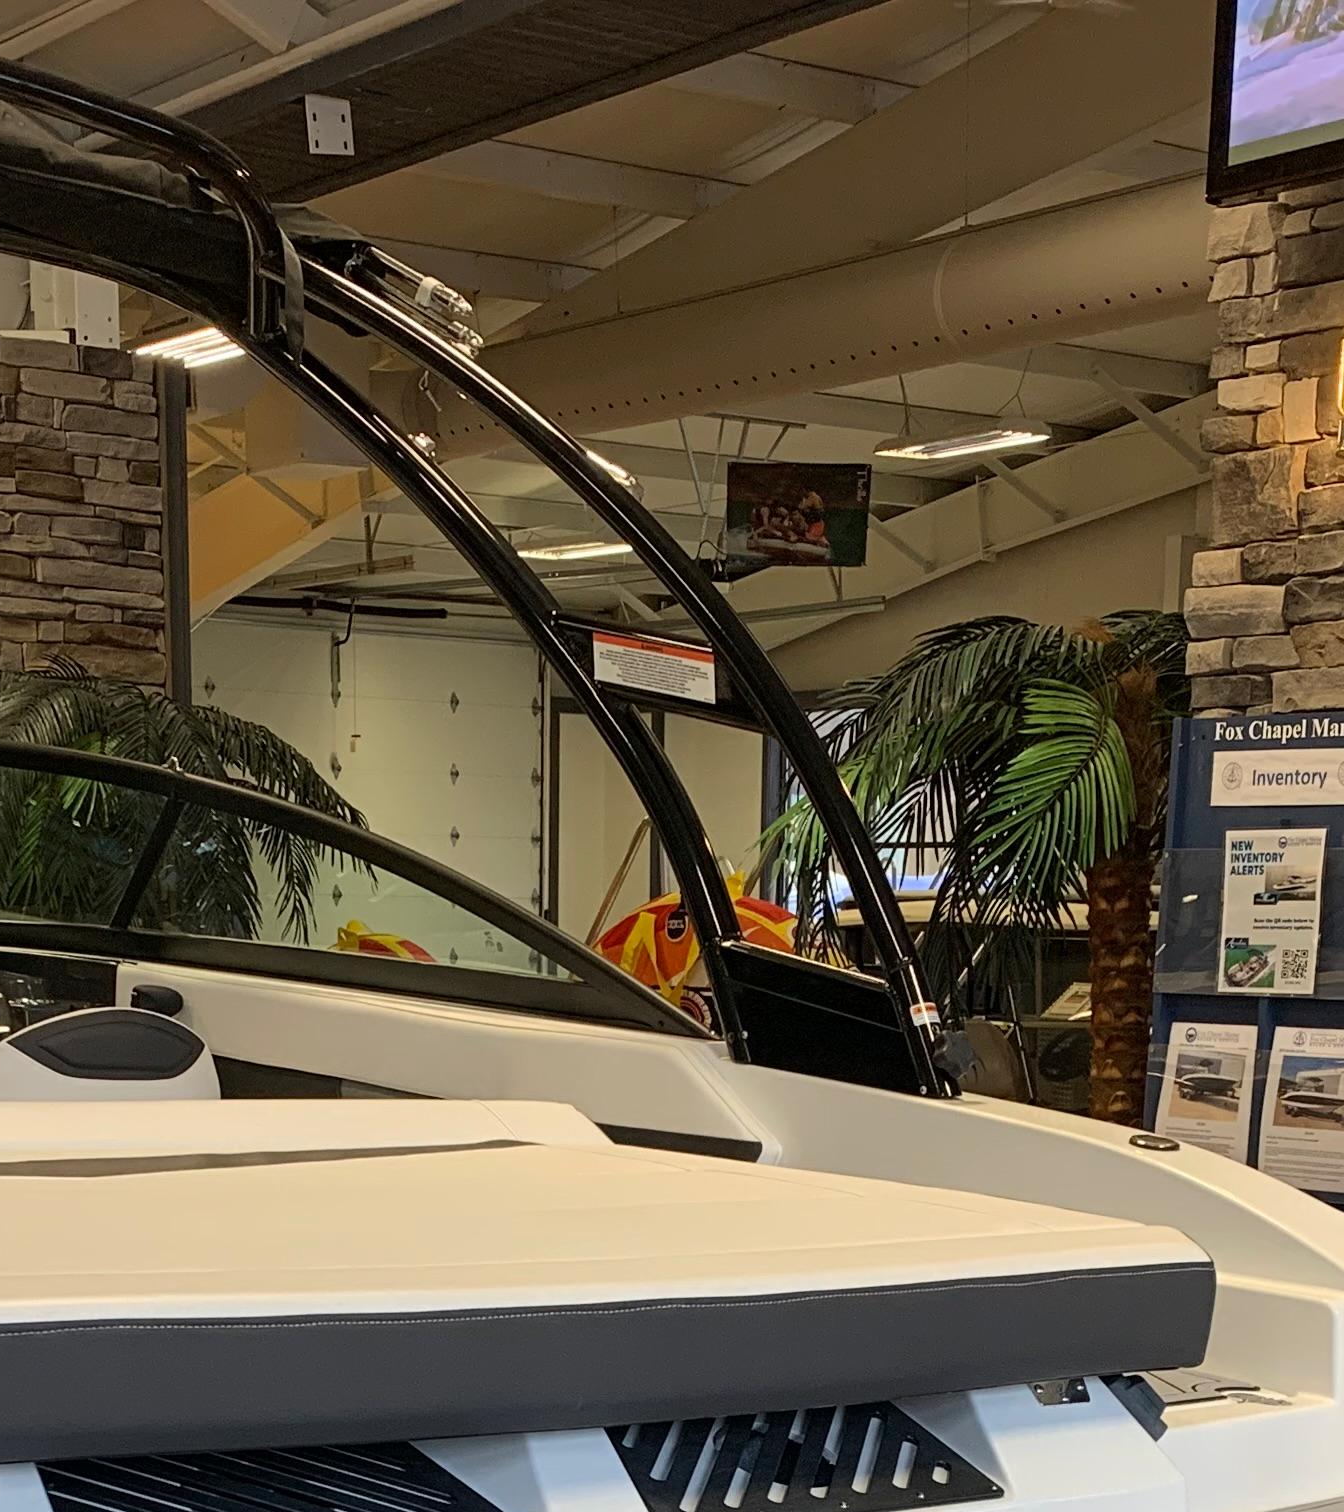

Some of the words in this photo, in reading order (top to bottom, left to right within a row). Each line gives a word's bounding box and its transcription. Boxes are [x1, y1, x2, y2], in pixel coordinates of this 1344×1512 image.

[1214, 721, 1244, 741] Fox
[1248, 719, 1306, 744] Chapel
[1252, 769, 1328, 789] Inventory
[1231, 840, 1254, 851] NEW
[1231, 852, 1284, 864] INVENTORY
[1230, 864, 1264, 876] ALERTS
